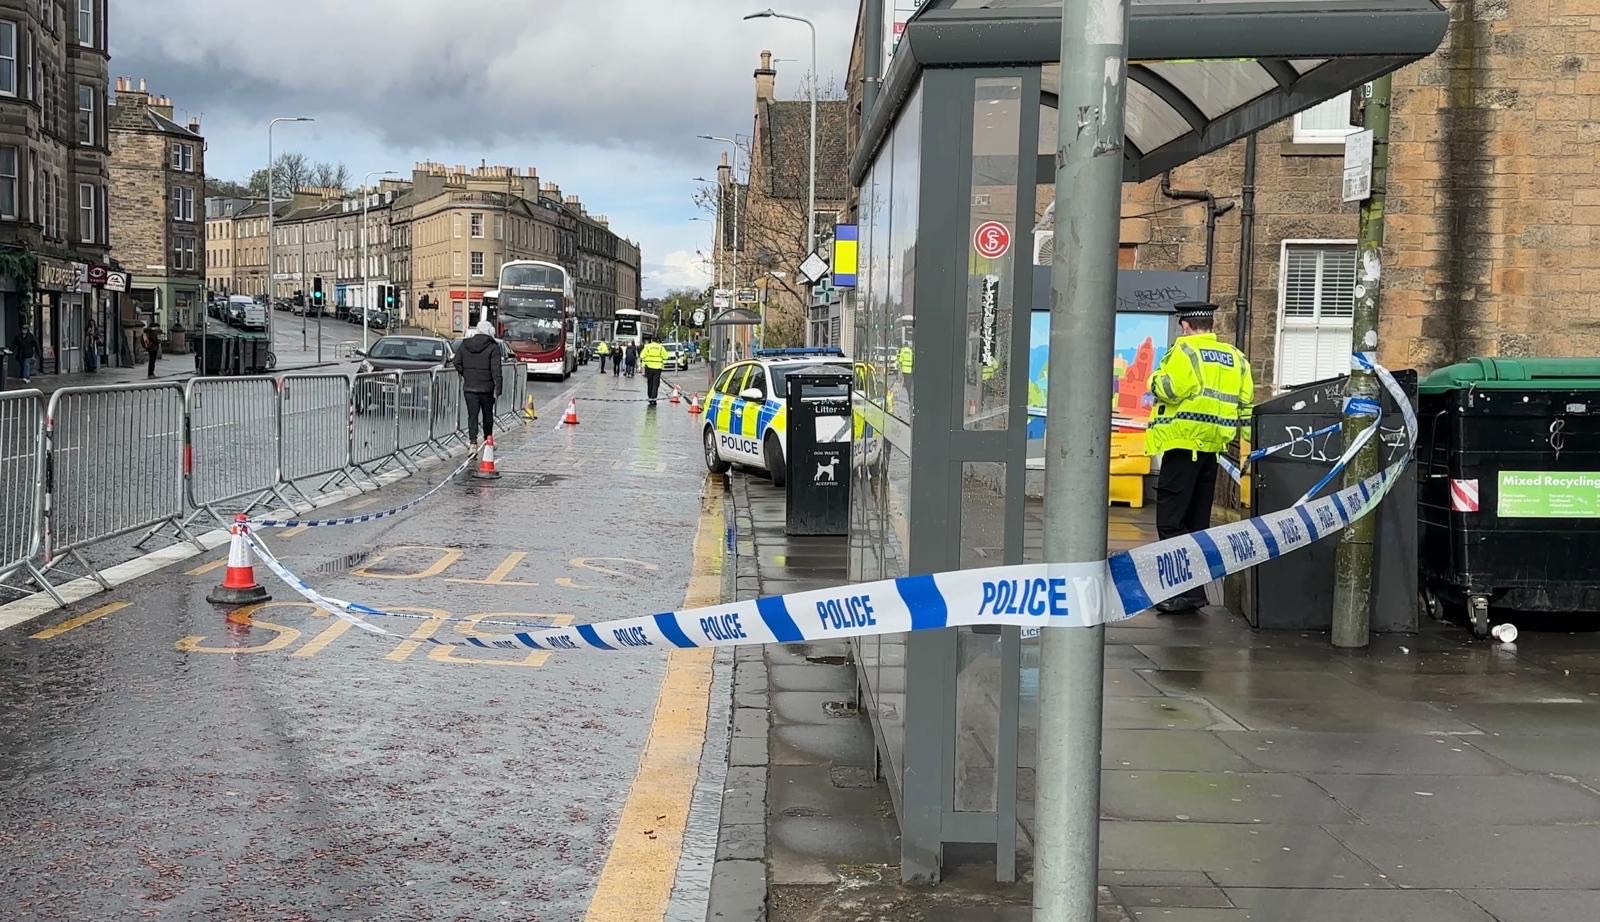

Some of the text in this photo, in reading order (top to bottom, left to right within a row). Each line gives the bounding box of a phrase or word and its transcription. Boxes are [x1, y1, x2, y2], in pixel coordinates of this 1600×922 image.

[1201, 349, 1234, 365] POLICE
[815, 405, 838, 413] Litter
[721, 435, 759, 455] POLICE
[1503, 475, 1600, 489] Mixed Recycling
[546, 635, 576, 648] POLICE
[613, 626, 653, 647] POLICE
[699, 613, 747, 641] POLICE
[815, 595, 877, 630] POLICE
[978, 578, 1069, 616] POLICE
[1156, 547, 1192, 590] POLICE
